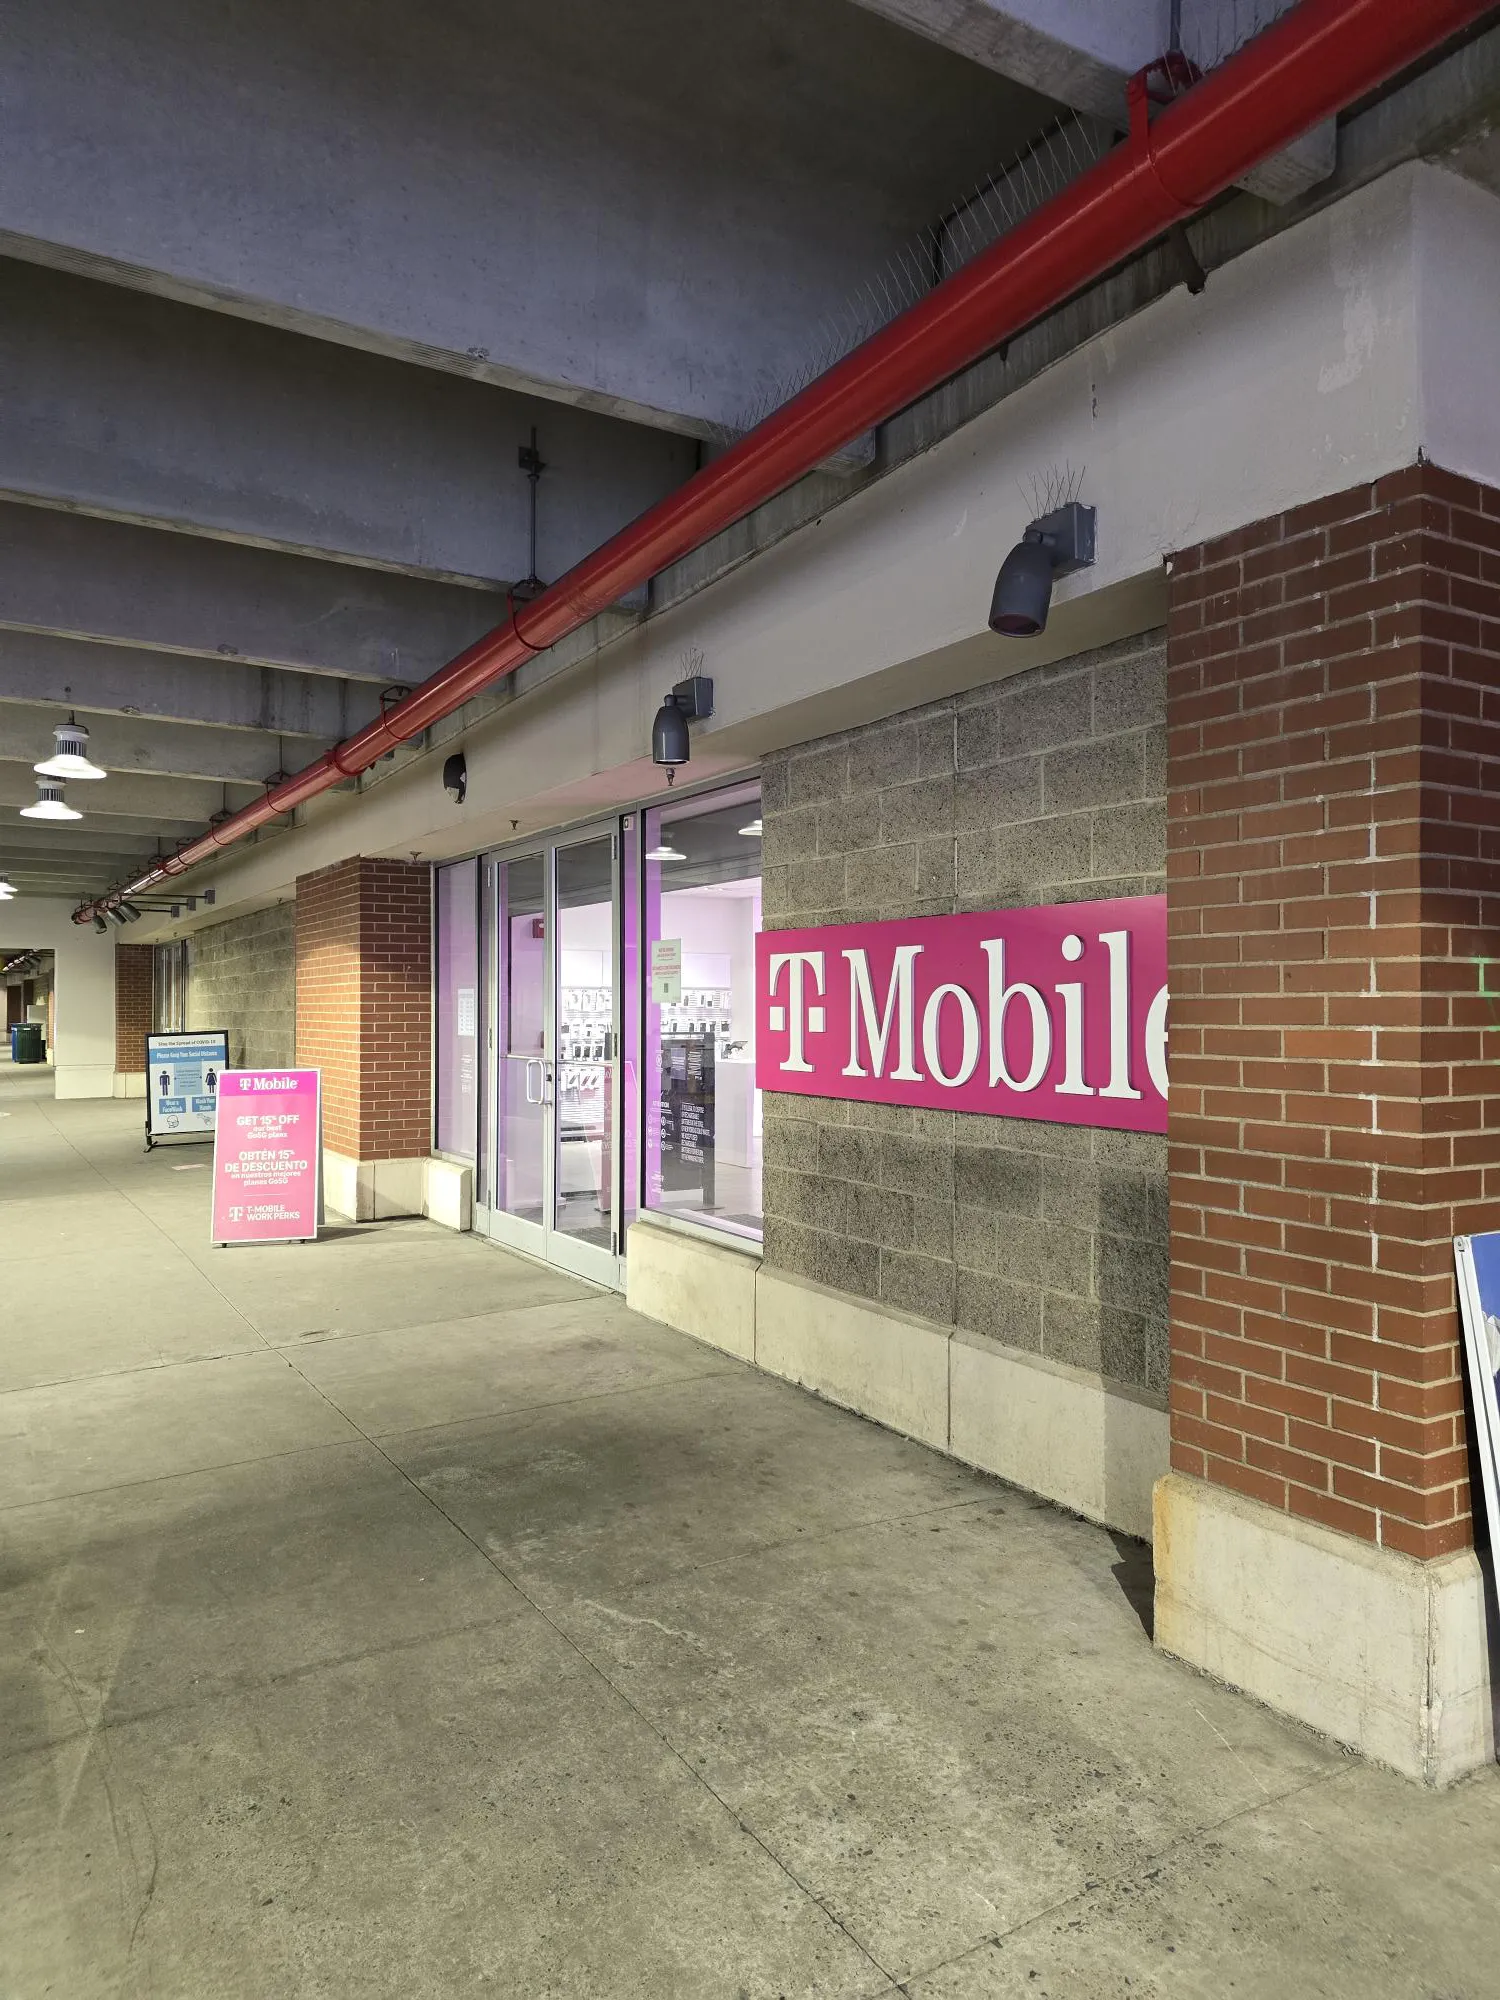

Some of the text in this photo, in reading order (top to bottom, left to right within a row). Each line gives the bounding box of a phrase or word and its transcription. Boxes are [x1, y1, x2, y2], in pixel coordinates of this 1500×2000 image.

[253, 1077, 298, 1090] Mobile
[236, 1115, 259, 1126] GET
[279, 1114, 300, 1124] OFF
[239, 1148, 276, 1160] OBTÉN
[225, 1160, 307, 1173] DE DESCUENTO
[246, 1204, 285, 1213] T-MOBILE
